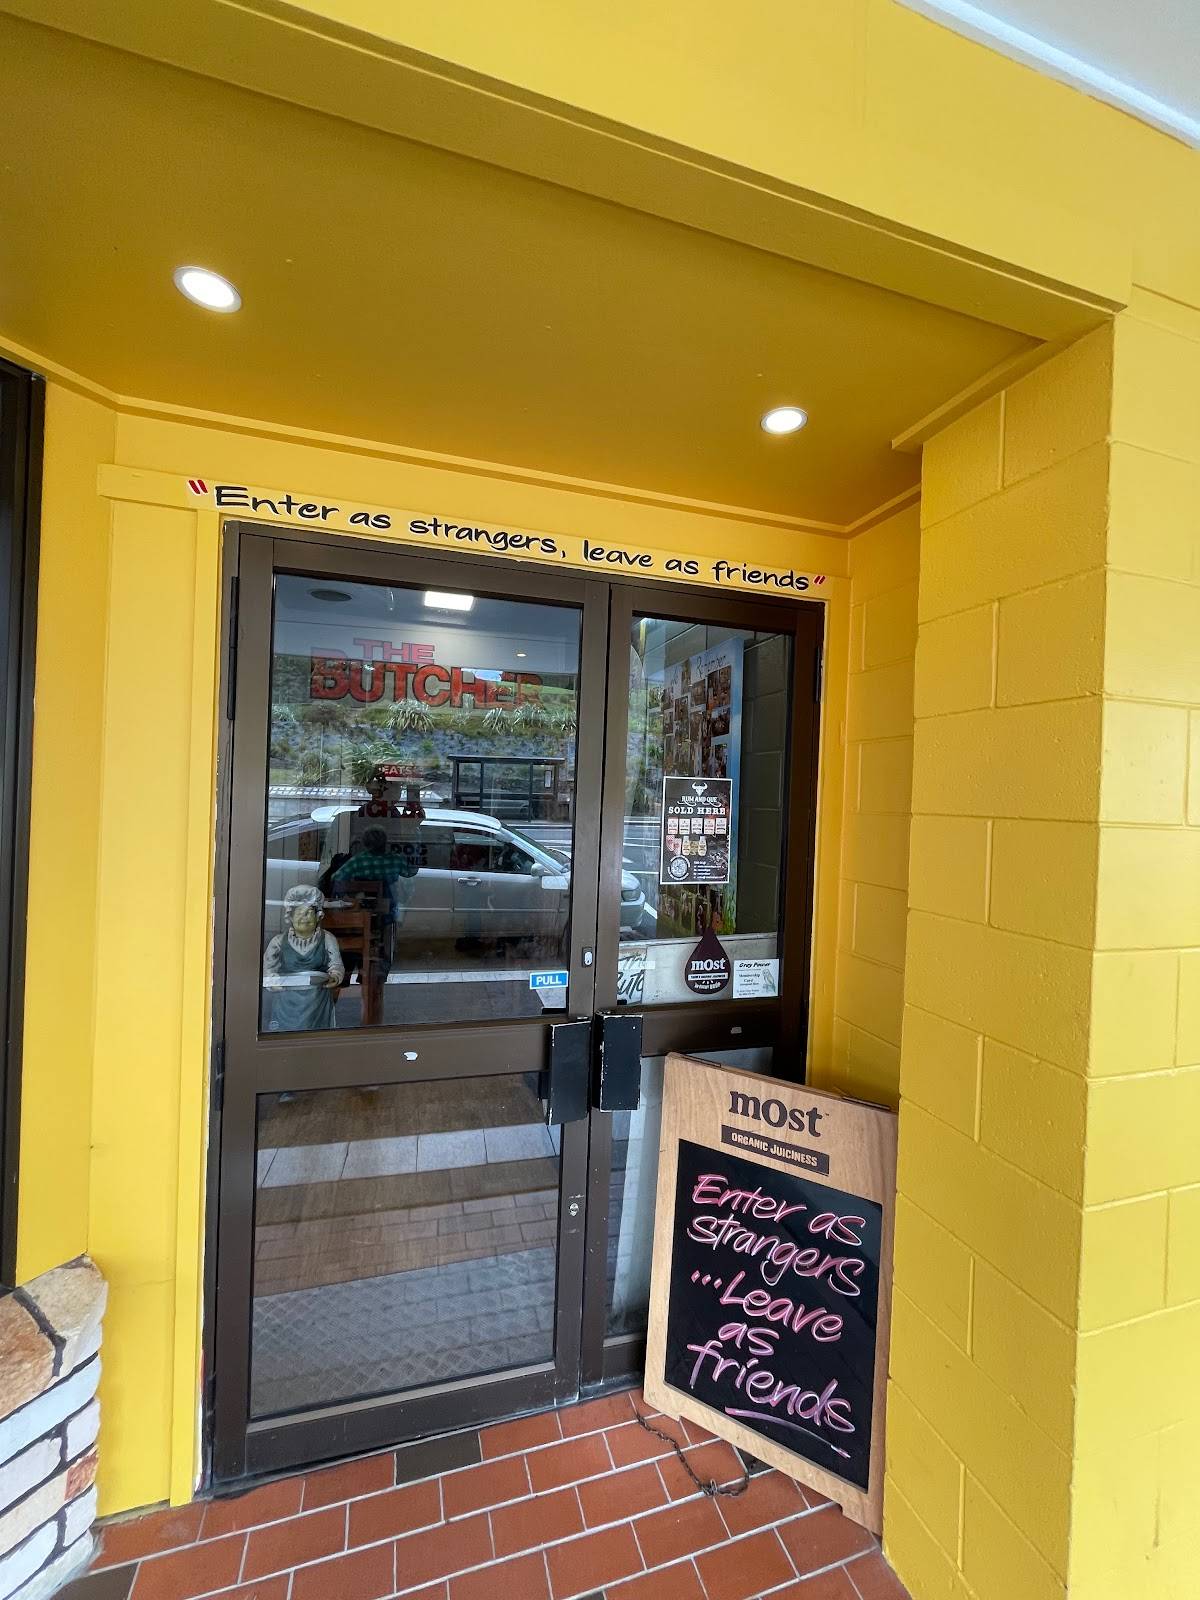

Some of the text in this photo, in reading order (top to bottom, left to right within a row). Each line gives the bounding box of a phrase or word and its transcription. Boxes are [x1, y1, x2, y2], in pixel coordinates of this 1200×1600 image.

[349, 512, 391, 529] as
[409, 517, 566, 559] strangers,
[583, 539, 654, 568] leave
[665, 558, 699, 575] as
[353, 637, 436, 665] THE
[310, 646, 546, 711] BUTCHER
[668, 806, 726, 815] SOLD HERE
[536, 975, 562, 986] PULL
[731, 1132, 818, 1167] ORGANIC JUICINESS
[692, 1173, 866, 1246] Enter as
[718, 1321, 780, 1356] as
[687, 1339, 856, 1433] friends
